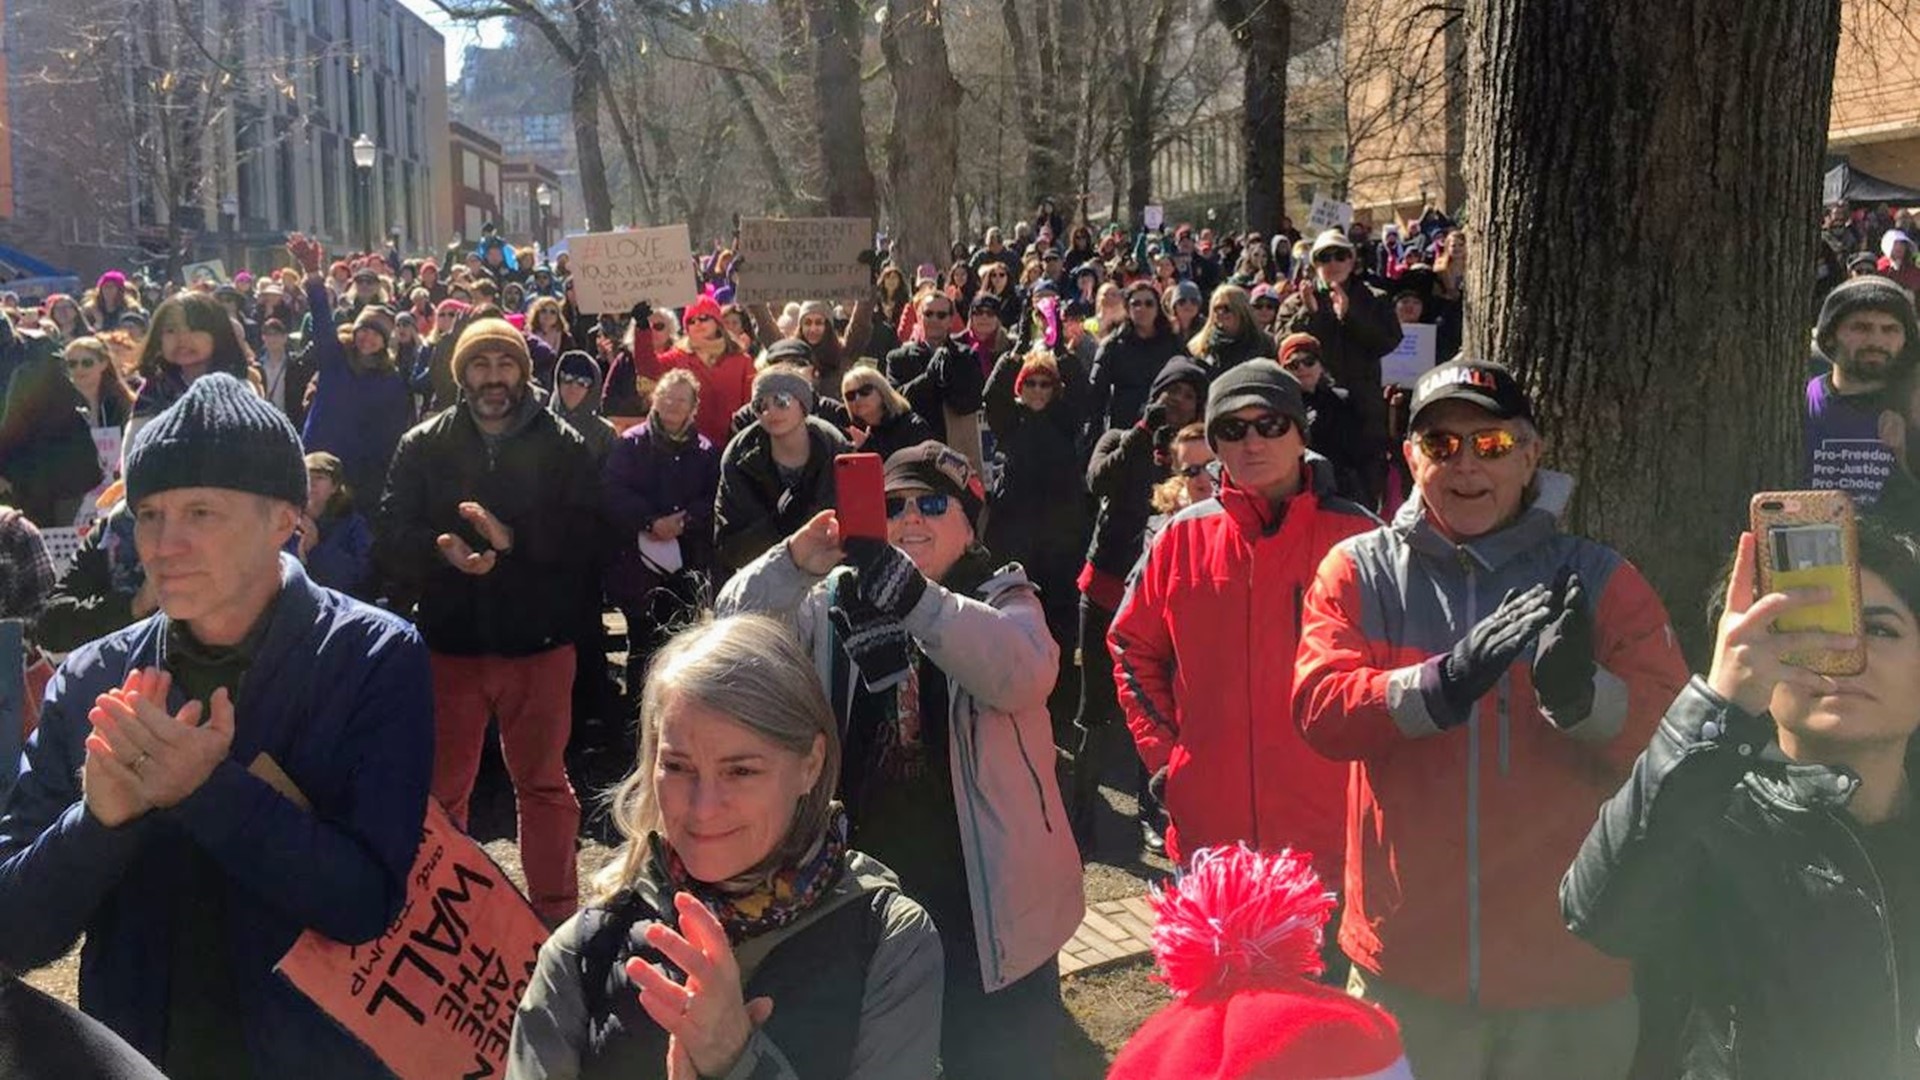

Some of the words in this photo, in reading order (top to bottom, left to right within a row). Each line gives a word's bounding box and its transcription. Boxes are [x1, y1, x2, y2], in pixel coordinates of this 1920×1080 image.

[766, 221, 858, 236] PRESIDENT
[577, 262, 624, 280] YOUR
[1418, 365, 1498, 402] KAMALA
[1812, 477, 1884, 491] Pro-Choice
[1813, 463, 1891, 477] Pro-Justice
[416, 845, 444, 891] and
[350, 900, 415, 997] TRUMP
[366, 862, 494, 1026] WALL
[434, 943, 496, 1032] THE
[458, 955, 510, 1048] ARE
